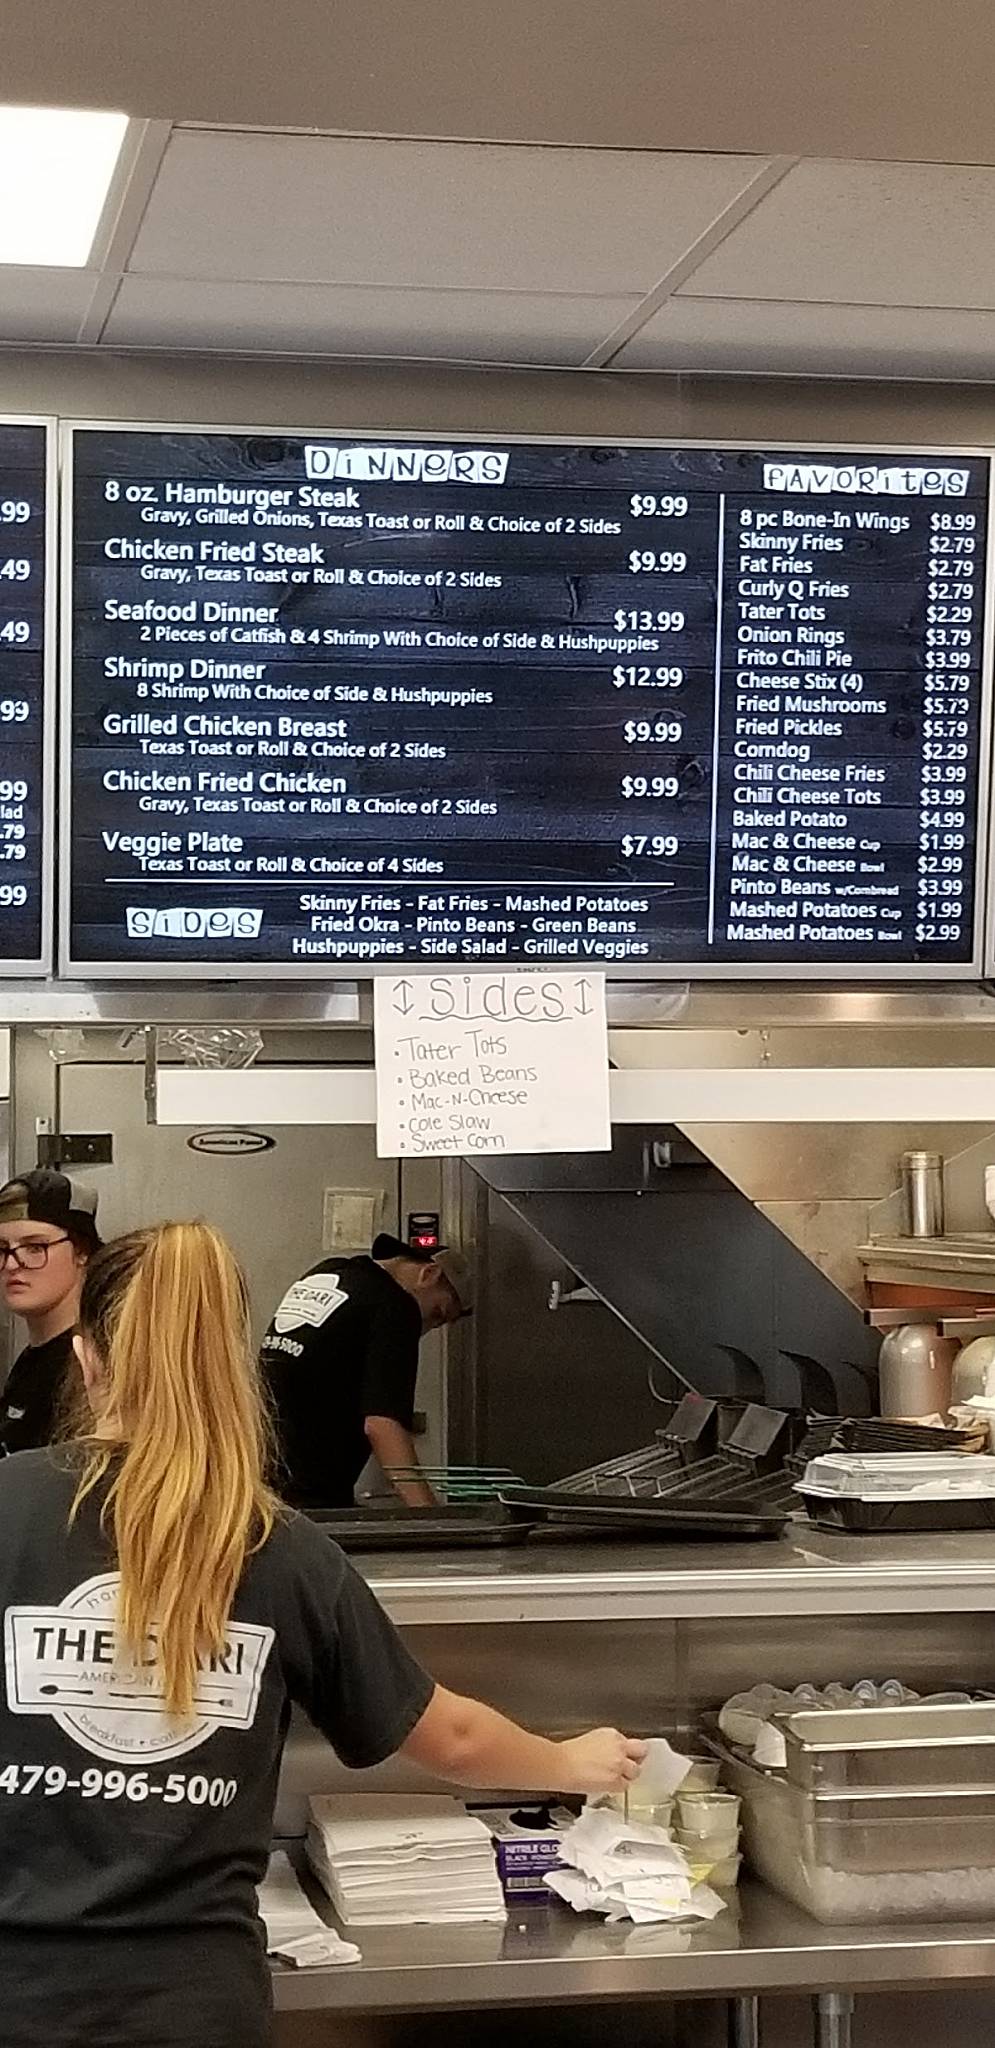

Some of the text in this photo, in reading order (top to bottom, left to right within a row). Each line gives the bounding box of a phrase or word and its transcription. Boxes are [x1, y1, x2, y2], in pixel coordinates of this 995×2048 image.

[105, 481, 687, 517] 8 oz. Hamburger Steak $9.99
[141, 507, 621, 533] Gravy, Grilled Onions, Texas Toast or Roll & Choice of 2 Sides
[740, 510, 975, 533] 8 pc Bone-In Wings $8.99
[740, 532, 975, 554] Skinny Fries $2.79
[105, 538, 686, 572] Chicken Fried Steak $9.99
[741, 556, 973, 577] Fat Fries $2.79
[739, 579, 973, 600] Curly Q Fries $2.79
[105, 600, 684, 632] Seafood Dinner $13.99
[738, 603, 972, 623] Tater Tots $2.29
[141, 626, 659, 653] 2 Pieces of Catfish & 4 Shrimp With Choice of Side & Hushpuppies
[738, 626, 971, 648] Onion Rings $3.79
[738, 649, 970, 669] Frito Chili Pie $3.99
[105, 657, 682, 687] Shrimp Dinner $12.99
[737, 672, 969, 692] Cheese Stix (4) $5.79
[104, 714, 681, 743] Grilled Chicken Breast $9.99
[736, 718, 968, 738] Fried Pickles $5.79
[735, 741, 968, 762] Corndog $2.29
[104, 770, 678, 798] Chicken Fried Chicken $9.99
[734, 764, 966, 783] Chili Cheese Fries $3.99
[733, 810, 964, 828] Baked Potato $4.99
[102, 832, 678, 857] Veggie Plate $7.99
[732, 833, 768, 848] Mac
[773, 833, 789, 848] &
[793, 833, 855, 849] Cheese
[920, 833, 964, 850] $1.99
[731, 878, 776, 894] Pinto
[781, 879, 831, 894] Beans
[918, 879, 962, 896] $3.99
[300, 895, 648, 914] Skinny Fries Fat Fries Mashed Potatoes
[312, 916, 636, 932] Fried Okra Pinto Beans Green Beans
[727, 924, 794, 940] Mashed
[800, 924, 873, 940] Potatoes
[916, 924, 960, 941] $2.99
[293, 938, 648, 958] Hushpuppies Side Salad Grilled Veggies
[430, 976, 565, 1018] Sides
[397, 1029, 507, 1061] Tater Tots
[408, 1064, 538, 1089] Baked Beans
[449, 1114, 491, 1130] Slaw
[411, 1133, 505, 1152] Sweet Corn
[33, 1627, 115, 1665] THE
[0, 1765, 238, 1807] 479-996-5000
